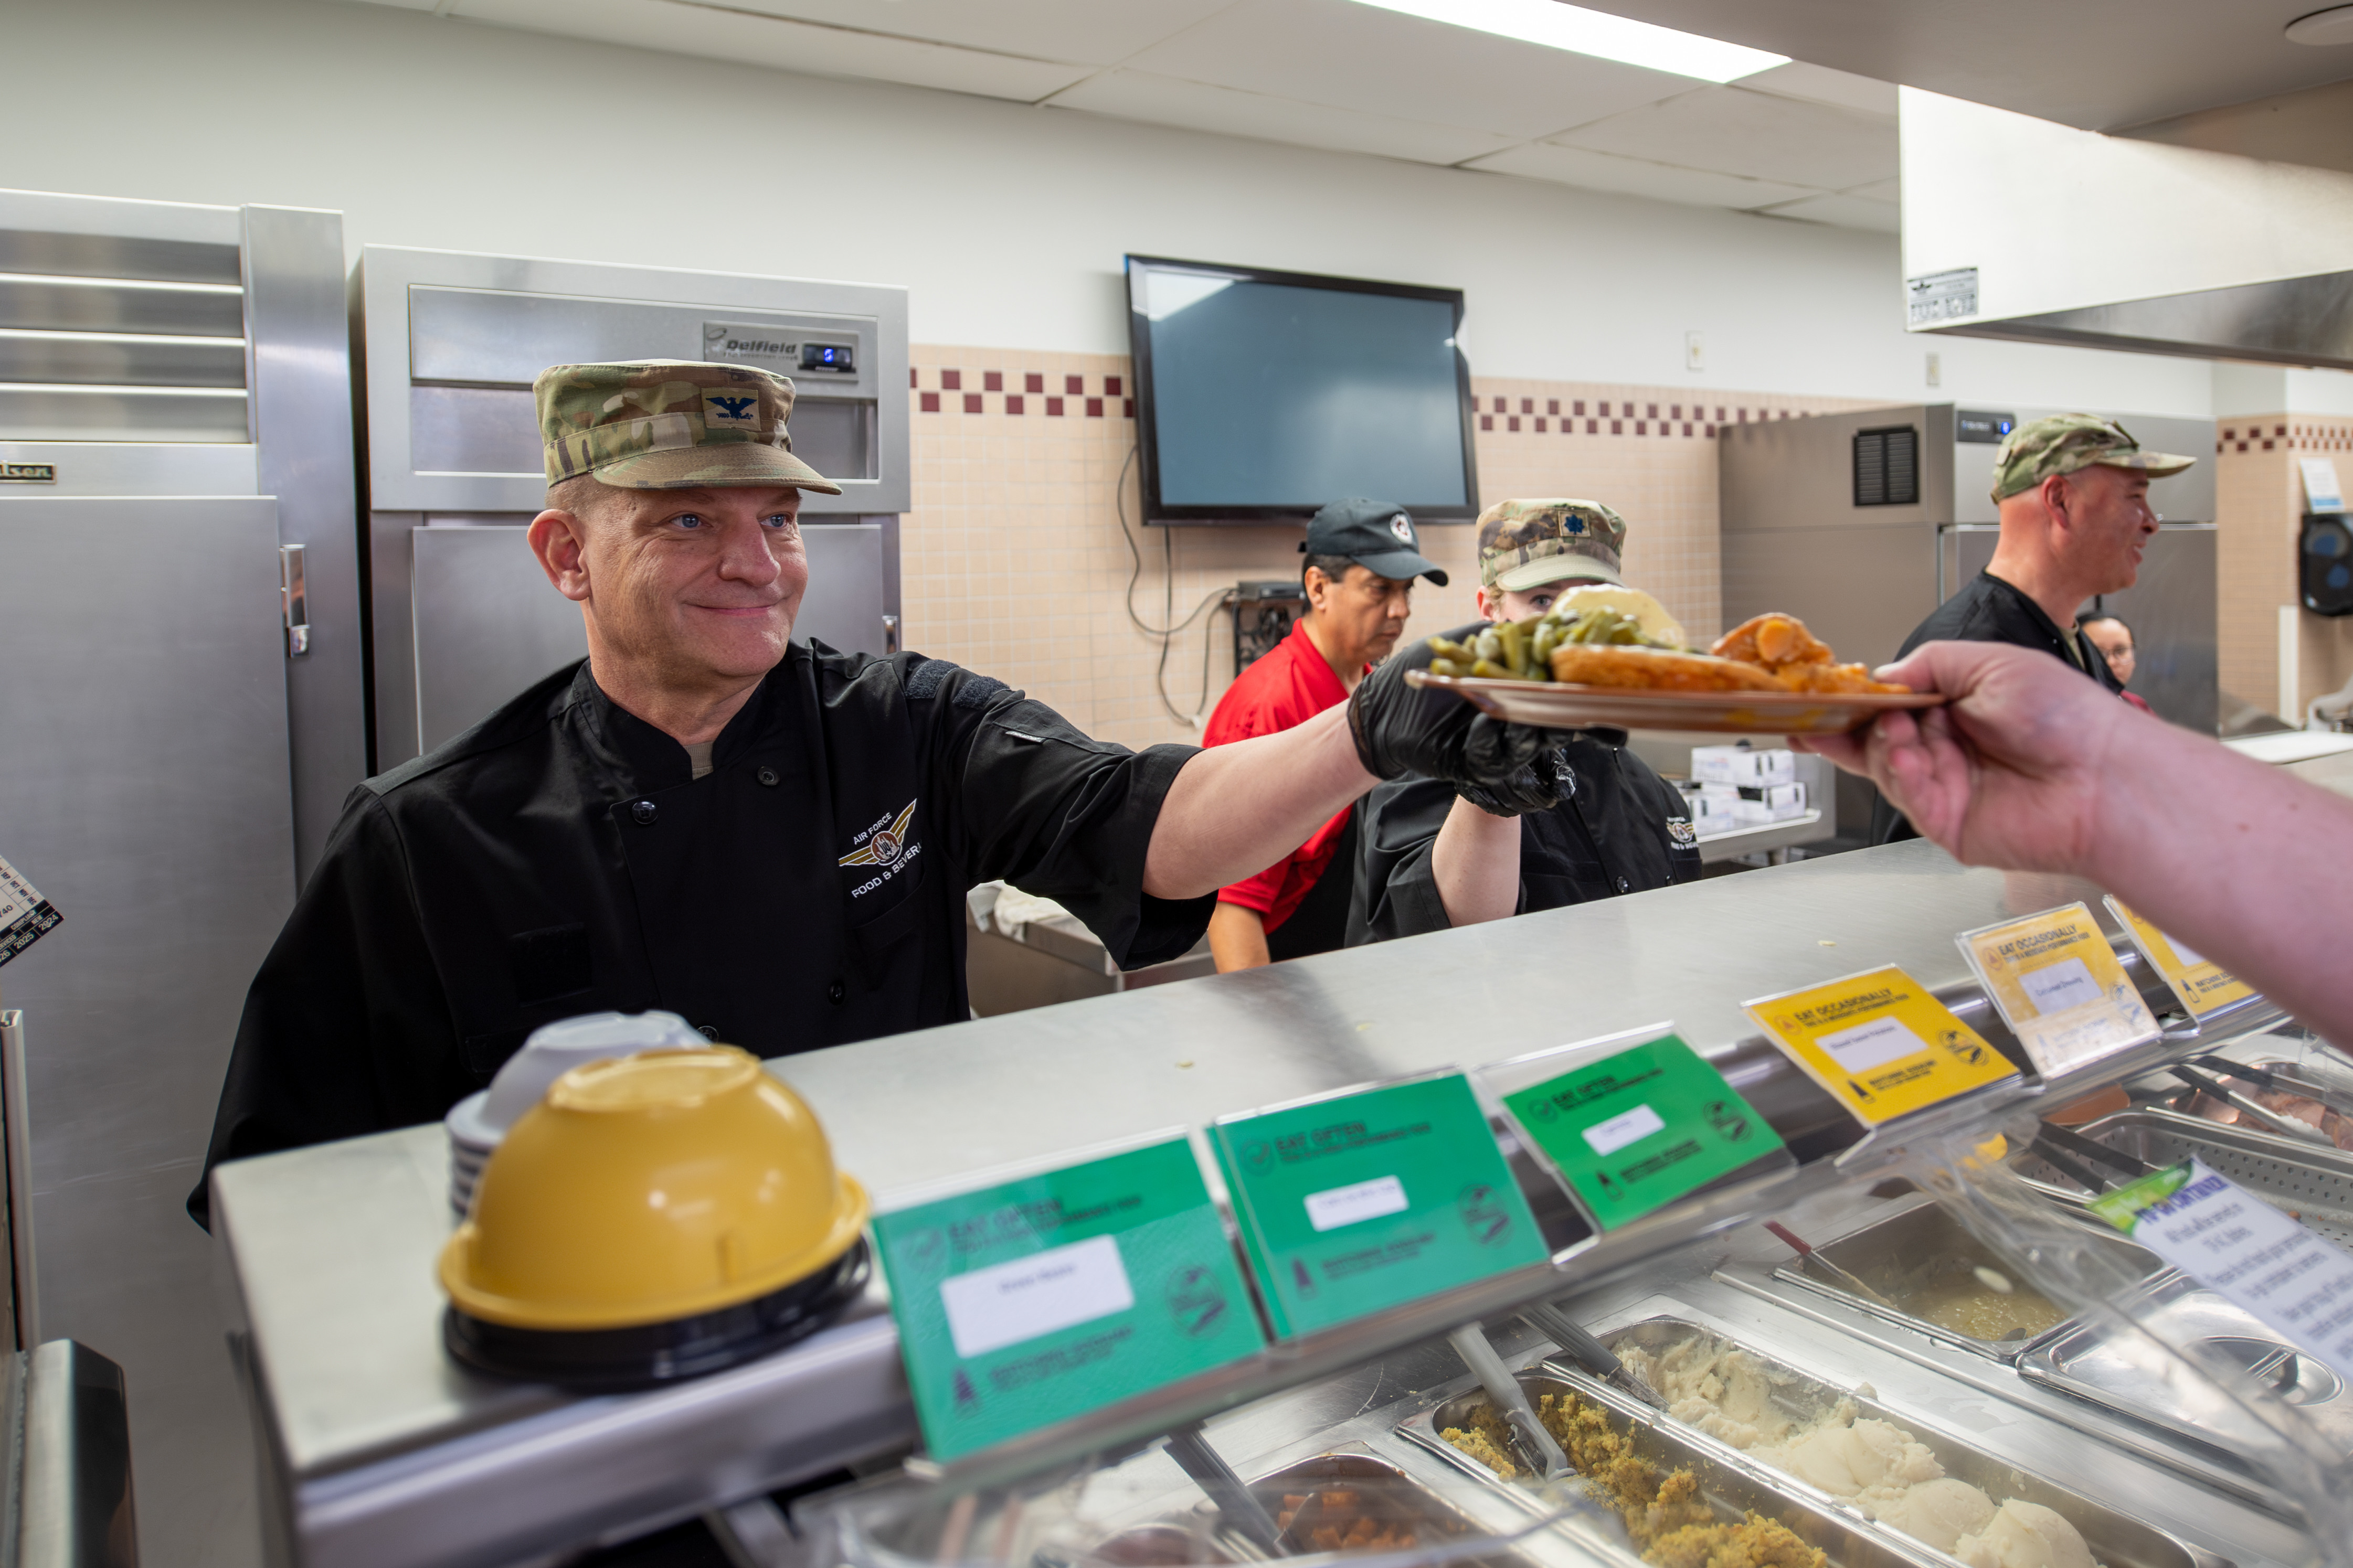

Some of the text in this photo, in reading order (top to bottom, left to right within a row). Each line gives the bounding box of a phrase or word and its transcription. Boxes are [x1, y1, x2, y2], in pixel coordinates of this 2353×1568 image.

[853, 812, 893, 845] AIR FORCE
[9, 880, 20, 889] OCT
[851, 877, 882, 898] FOOD
[882, 871, 892, 880] &
[18, 888, 29, 898] NOV
[27, 897, 37, 905] DEC
[14, 932, 34, 950] 2025
